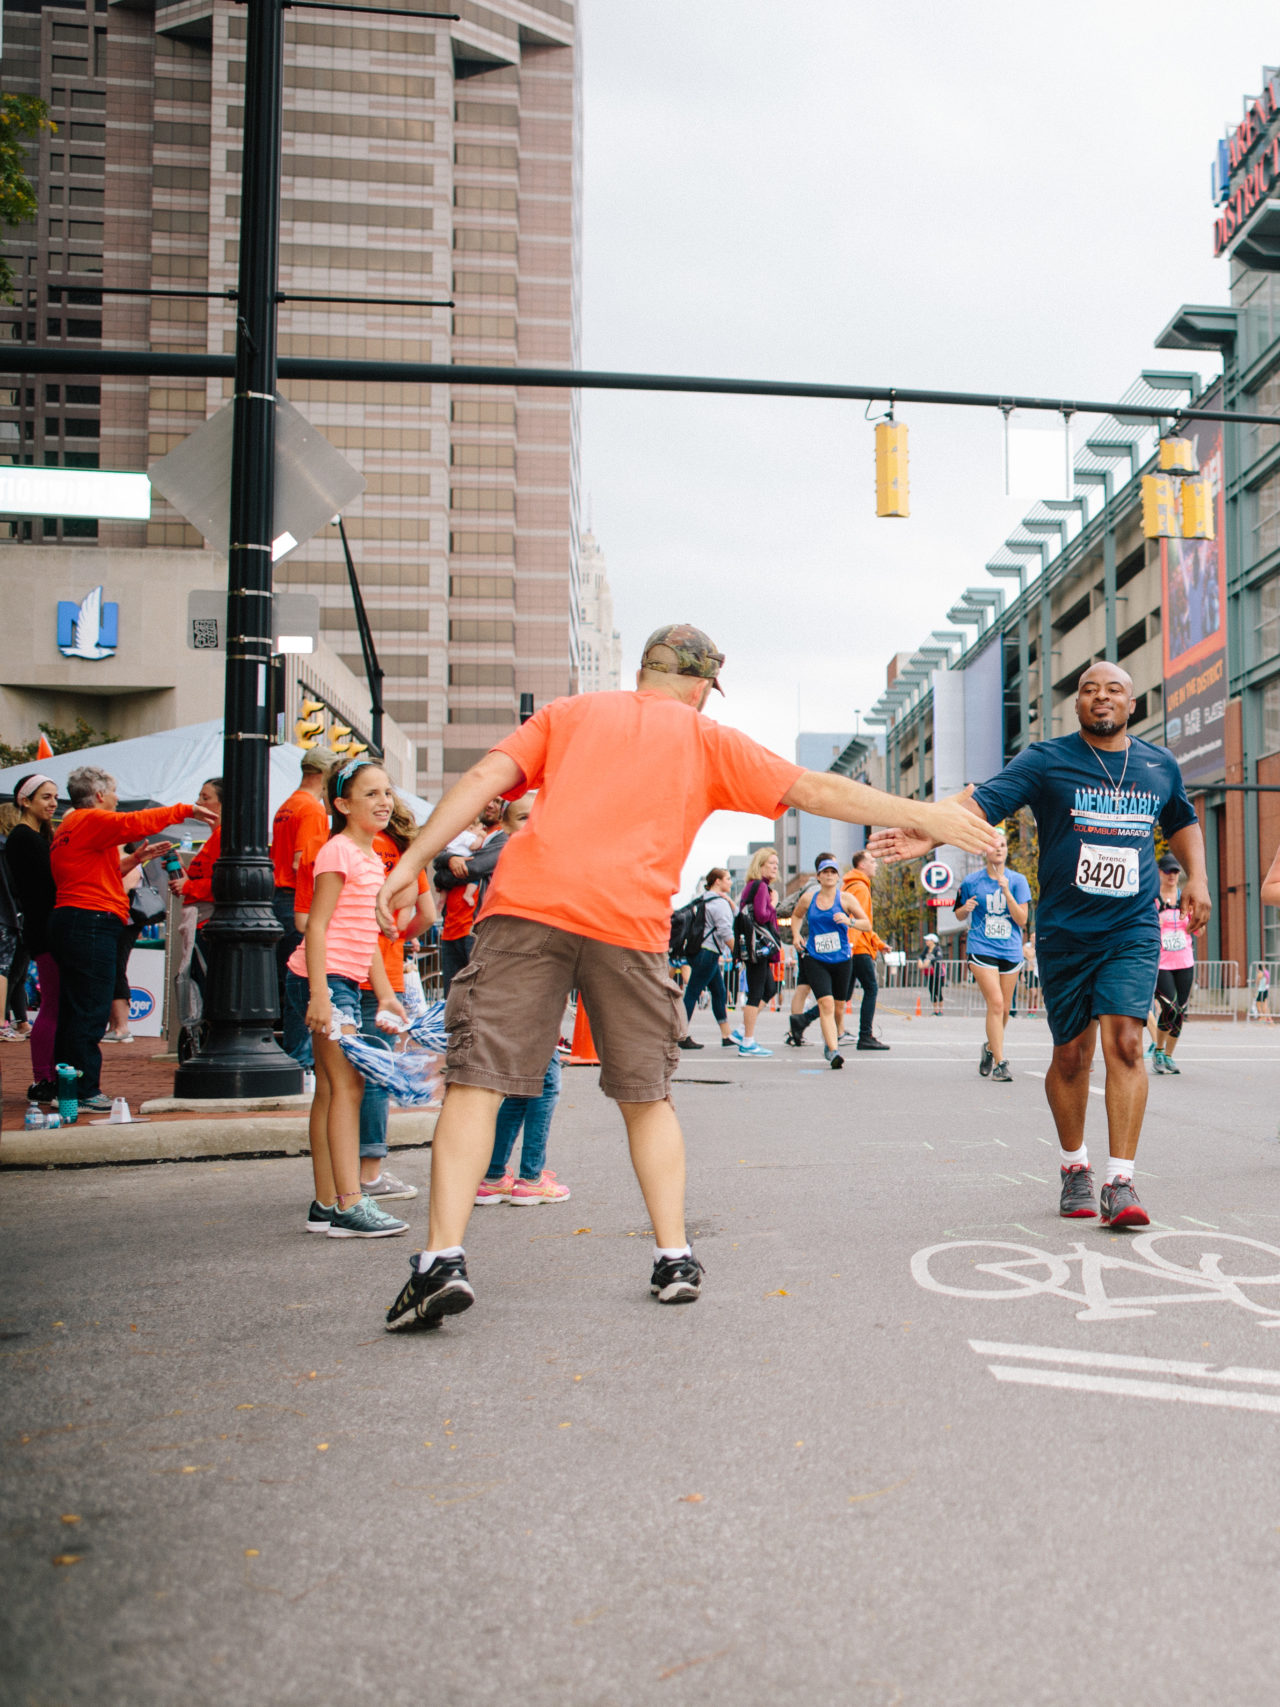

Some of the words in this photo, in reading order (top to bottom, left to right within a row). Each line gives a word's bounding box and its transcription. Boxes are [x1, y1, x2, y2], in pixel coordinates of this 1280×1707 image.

[1228, 81, 1280, 176] ARENA
[1213, 131, 1280, 257] DISTRICT
[1197, 658, 1223, 695] DISTRICT
[1075, 792, 1160, 816] MEMORABLE
[1098, 853, 1127, 863] Terence
[930, 866, 948, 888] P
[1078, 859, 1126, 889] 3420
[1127, 868, 1137, 886] C
[986, 923, 1006, 936] 3546
